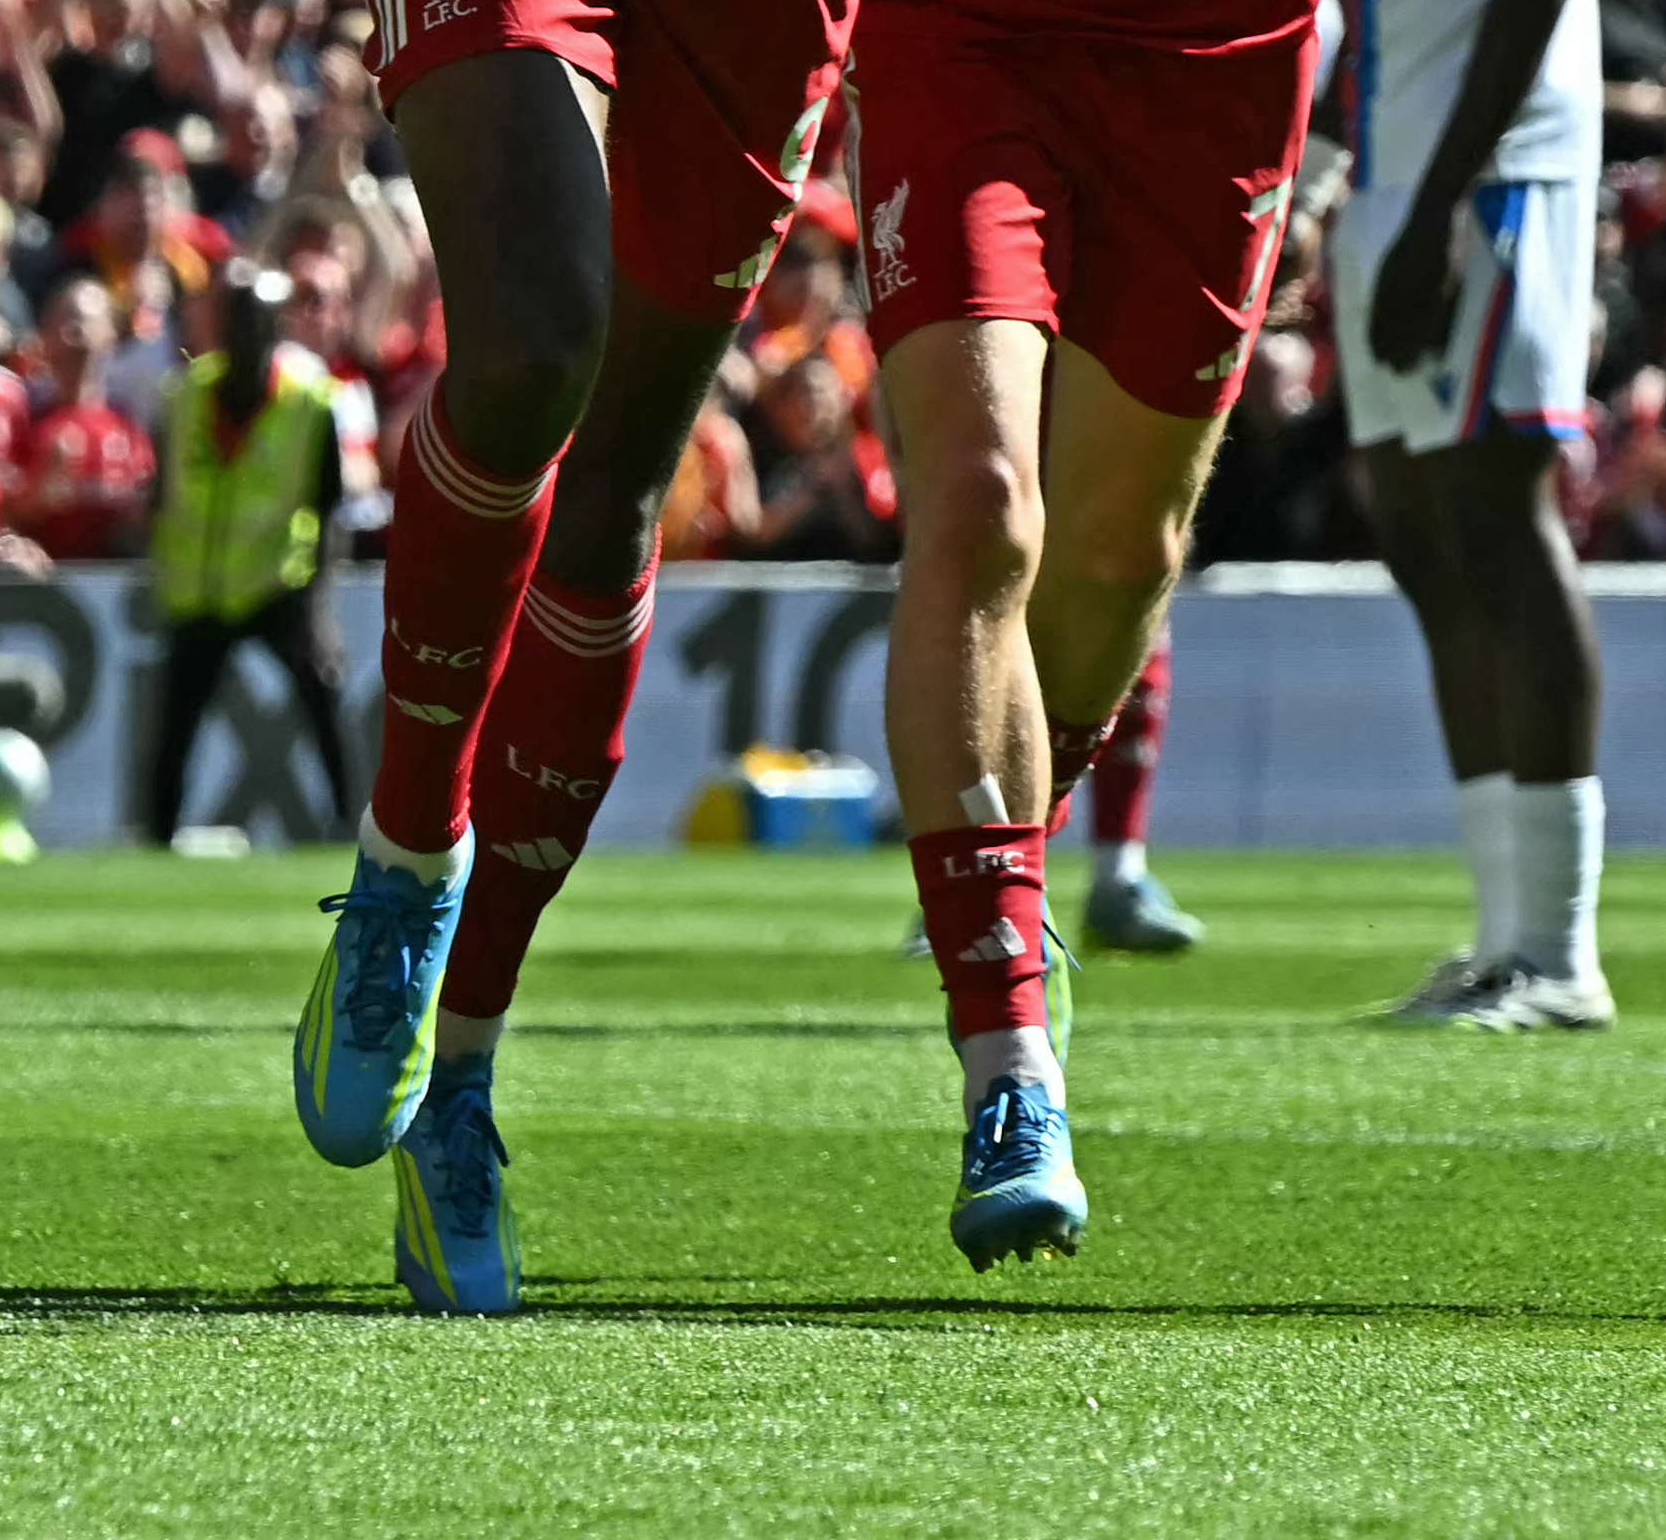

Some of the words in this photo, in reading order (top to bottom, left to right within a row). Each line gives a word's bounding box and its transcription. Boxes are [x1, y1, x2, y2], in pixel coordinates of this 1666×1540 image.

[391, 617, 484, 669] LFC
[507, 743, 600, 800] LFC
[943, 850, 1025, 878] LFC
